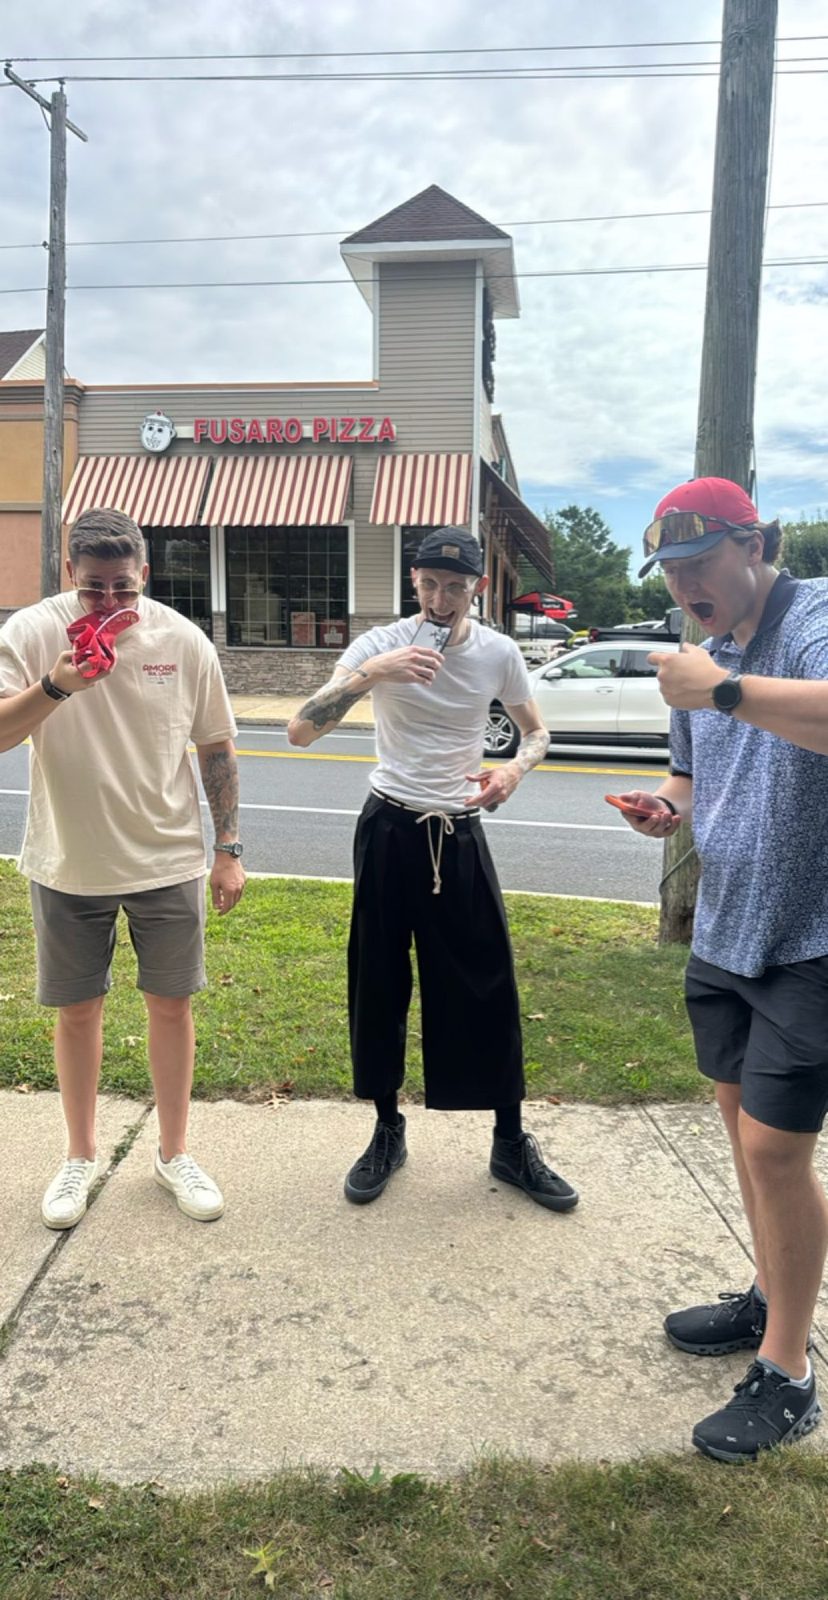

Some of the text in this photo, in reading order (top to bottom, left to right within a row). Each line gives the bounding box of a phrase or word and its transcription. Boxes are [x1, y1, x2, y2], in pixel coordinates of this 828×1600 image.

[193, 417, 396, 443] FUSARO PIZZA
[143, 664, 177, 672] AMORE
